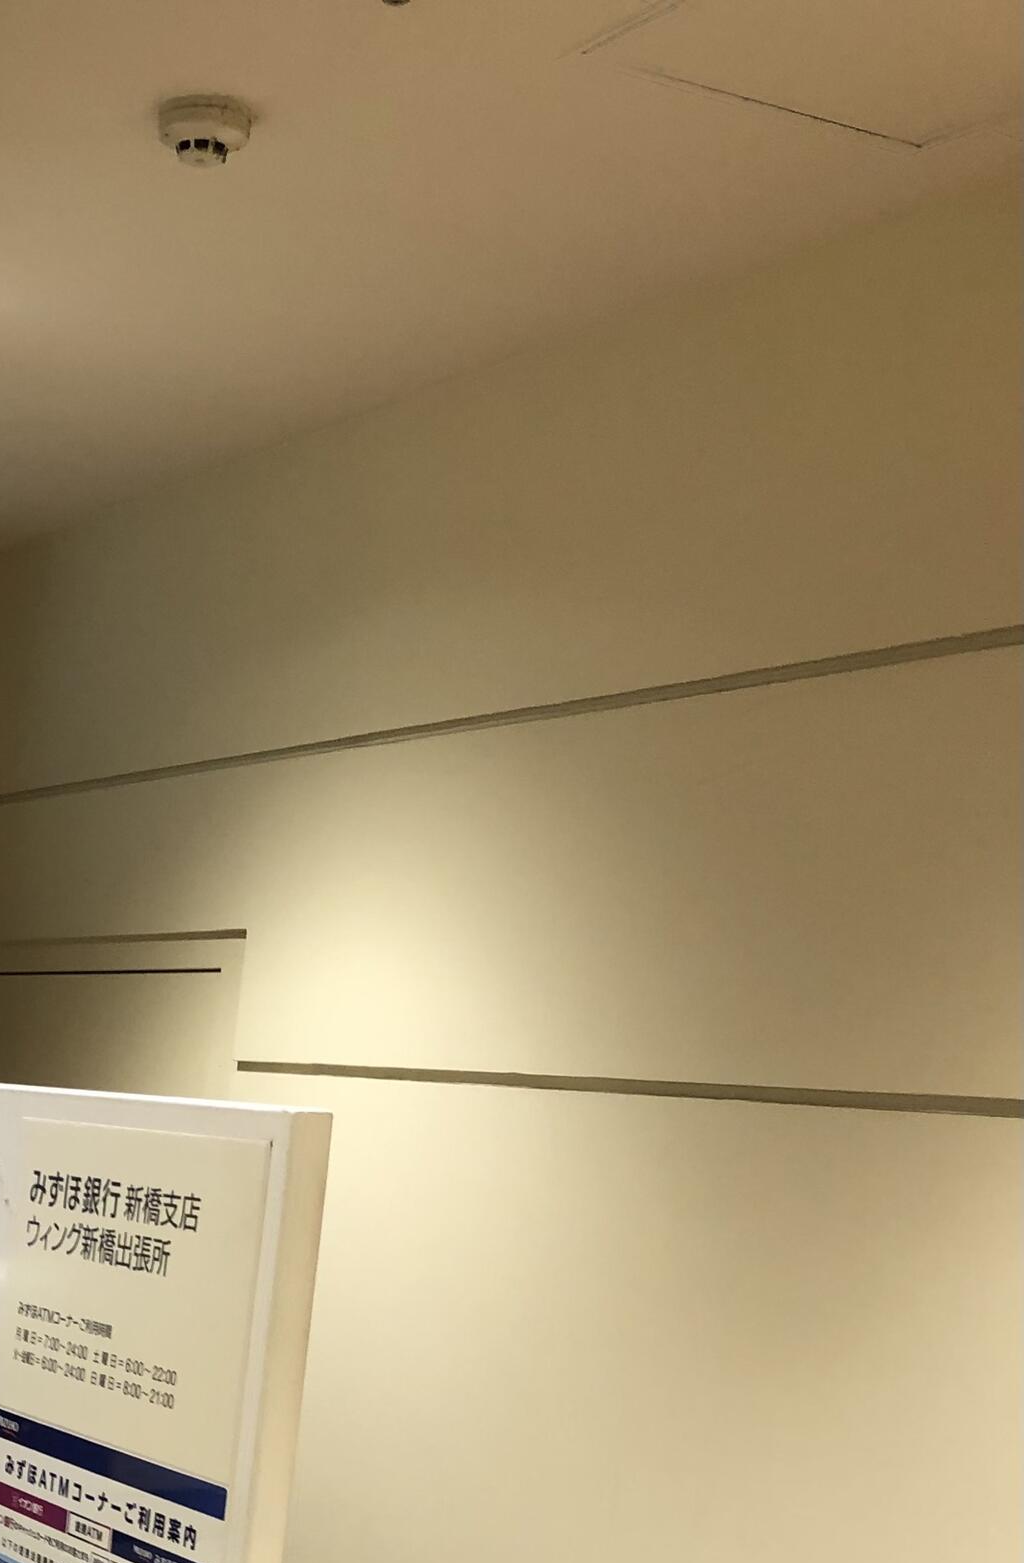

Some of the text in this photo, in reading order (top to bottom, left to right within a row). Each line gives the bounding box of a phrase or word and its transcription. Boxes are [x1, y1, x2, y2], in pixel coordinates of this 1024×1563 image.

[30, 1170, 201, 1232] みずほ銀行 新橋支店
[26, 1216, 171, 1277] ウィング新橋出張所
[4, 1454, 197, 1551] みずほATMコーナーご利用案内
